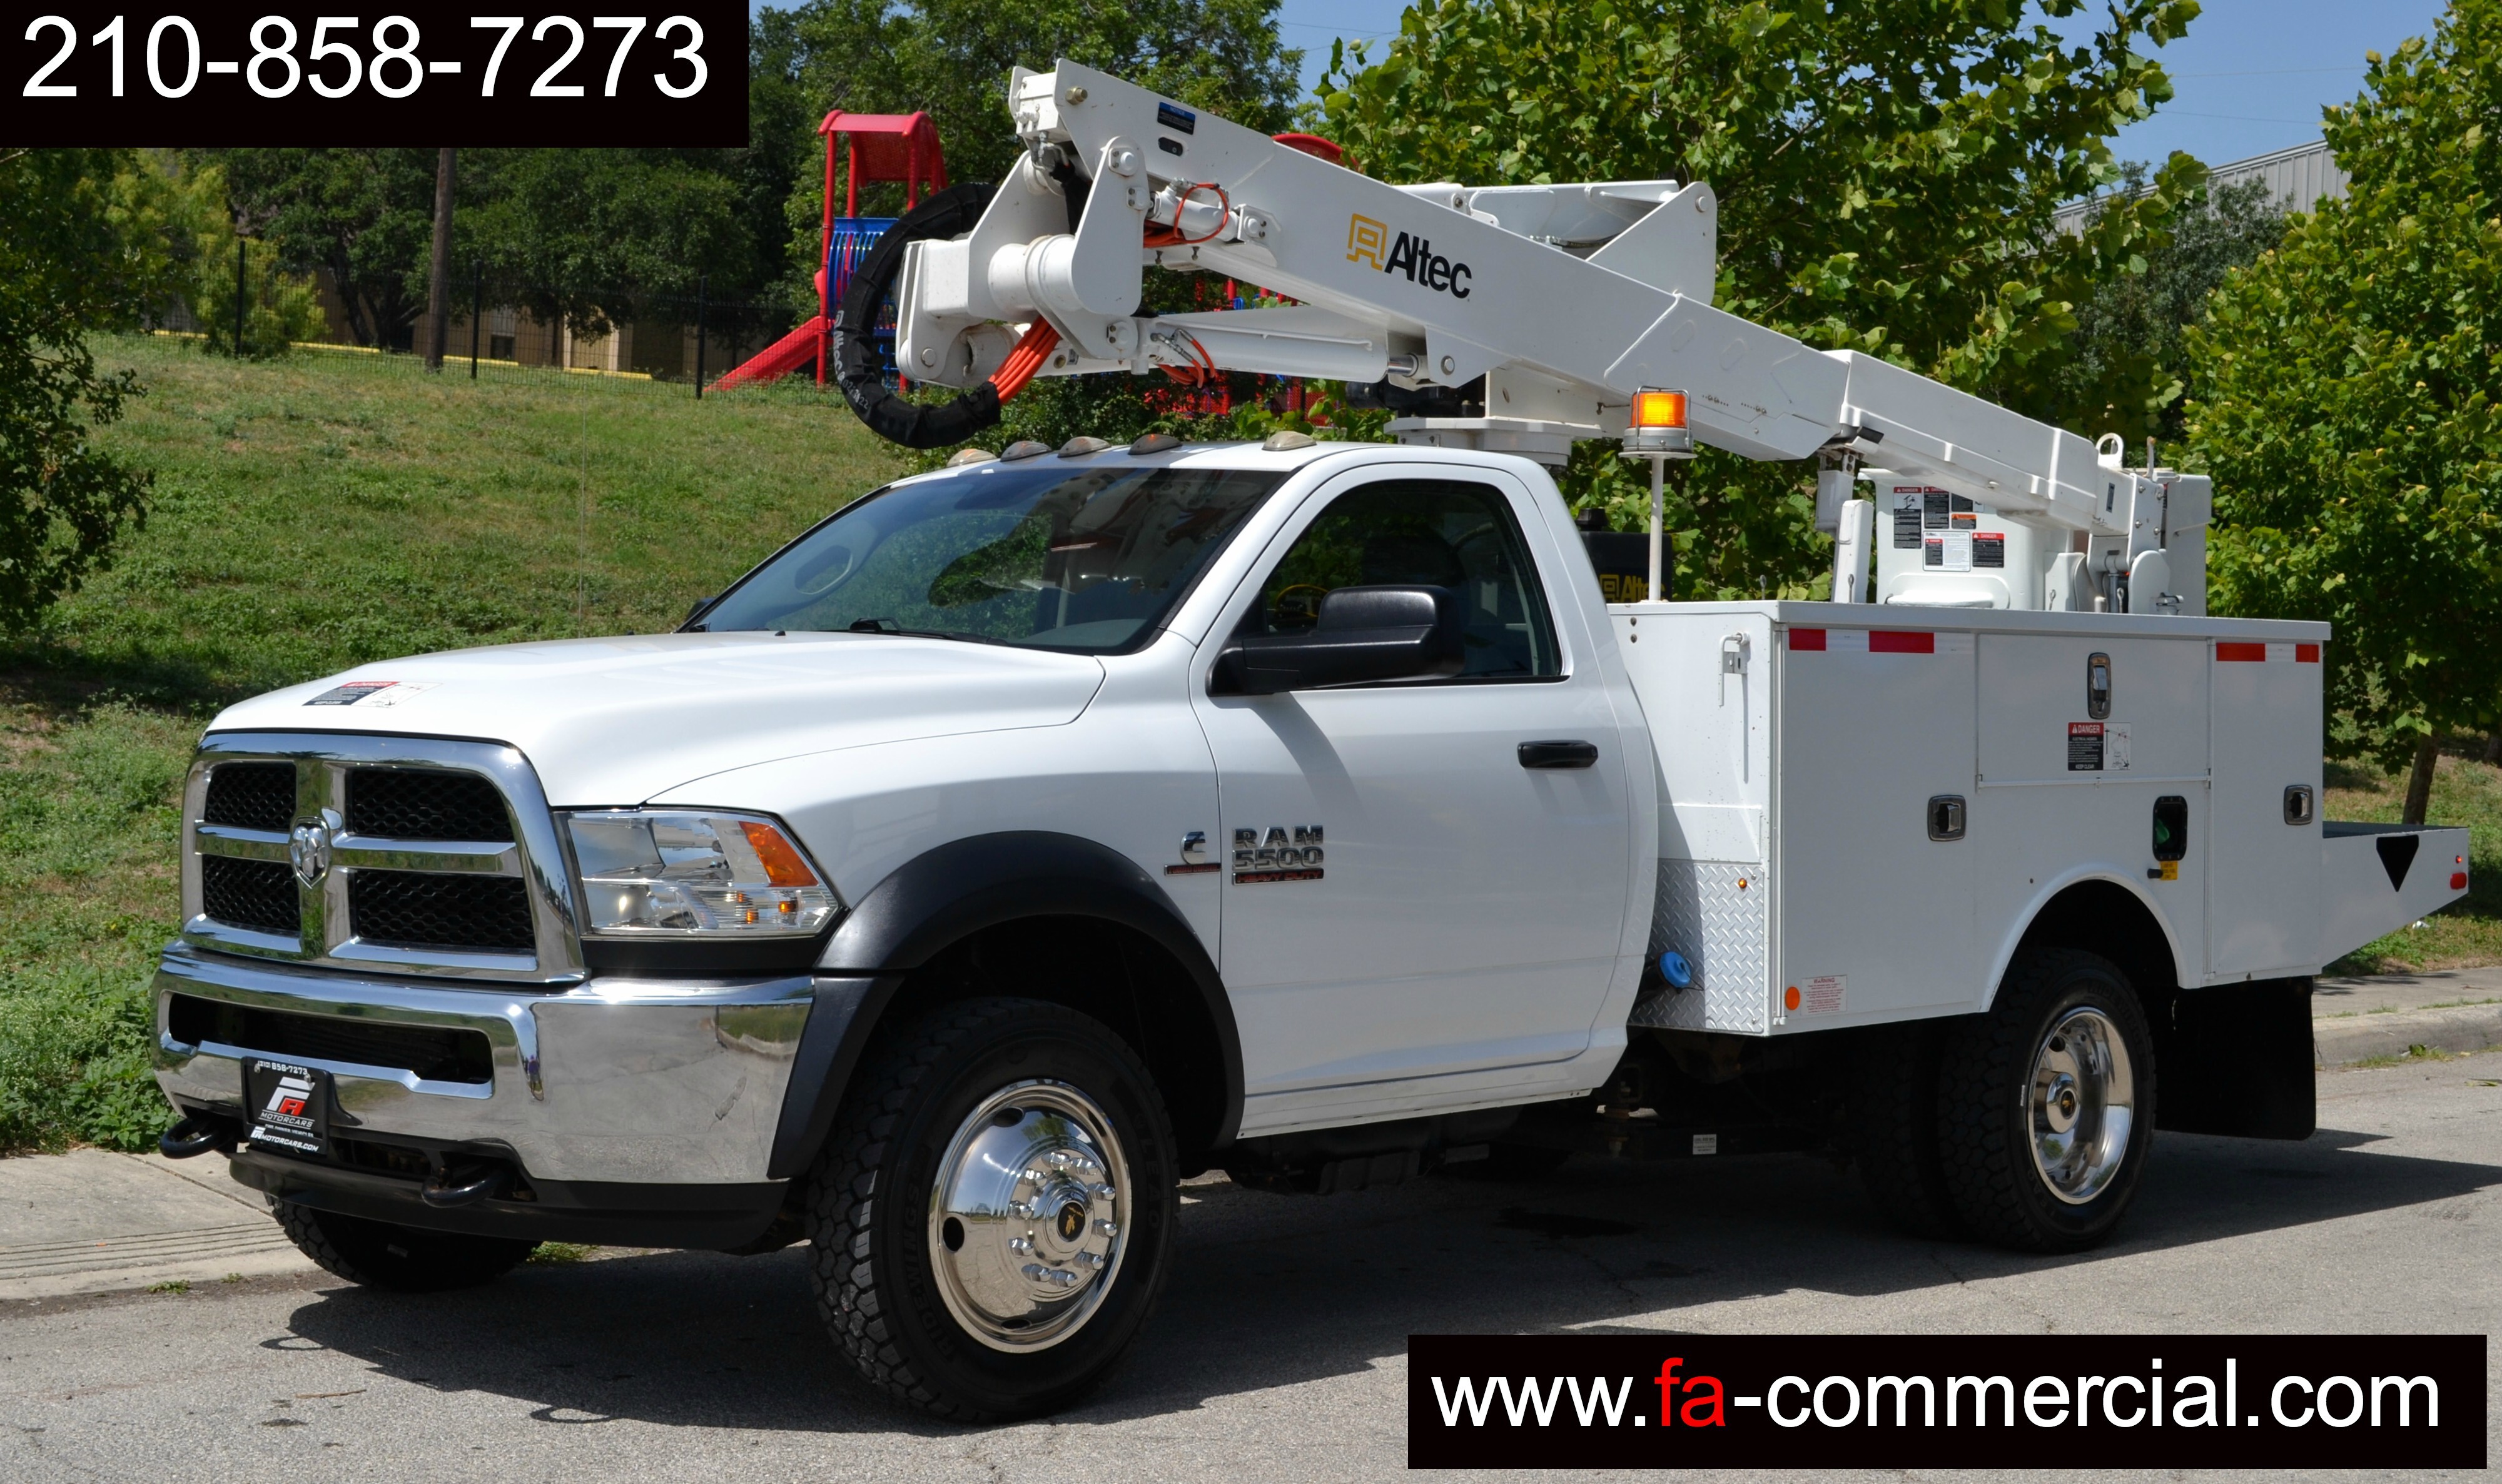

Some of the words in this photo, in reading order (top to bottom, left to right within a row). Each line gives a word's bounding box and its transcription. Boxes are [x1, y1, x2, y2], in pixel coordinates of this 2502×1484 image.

[1384, 231, 1472, 298] Altec
[2078, 725, 2100, 734] DANGER
[1232, 825, 1324, 848] RAM
[1232, 846, 1324, 871] 5500
[271, 1062, 308, 1075] 858-7273
[260, 1112, 313, 1128] MOTORCARS
